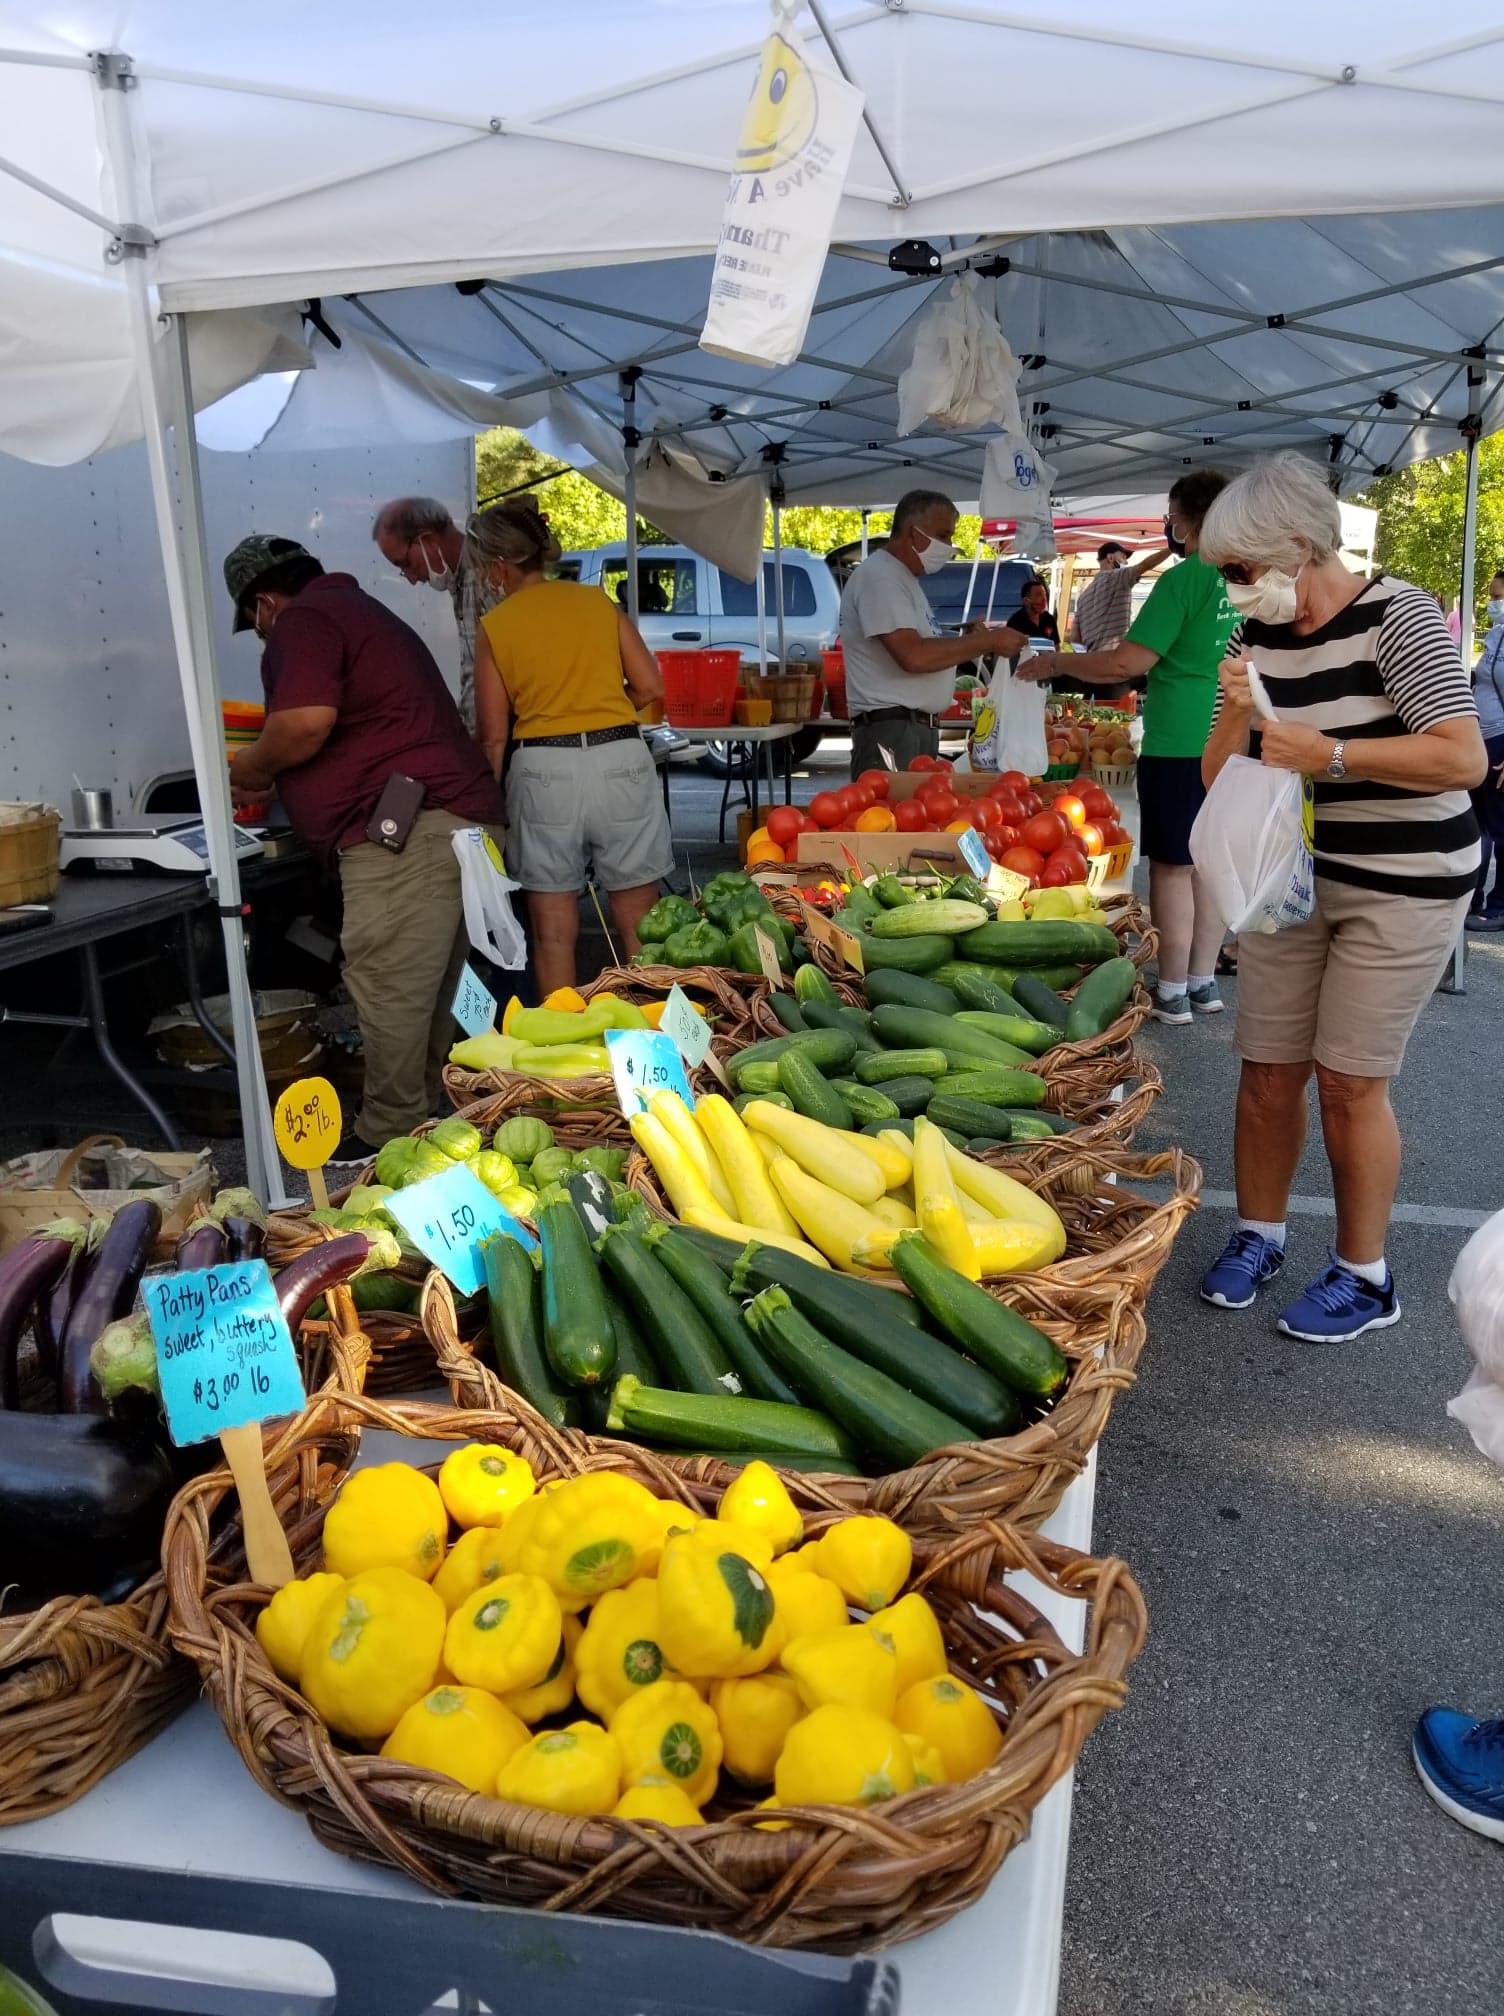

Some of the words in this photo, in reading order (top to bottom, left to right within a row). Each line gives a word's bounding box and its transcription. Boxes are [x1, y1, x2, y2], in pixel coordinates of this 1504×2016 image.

[626, 1056, 669, 1087] $1.50
[424, 1204, 475, 1250] $1.50
[157, 1283, 206, 1322] Patty
[206, 1273, 252, 1306] Pans
[193, 1373, 239, 1410] $3.00
